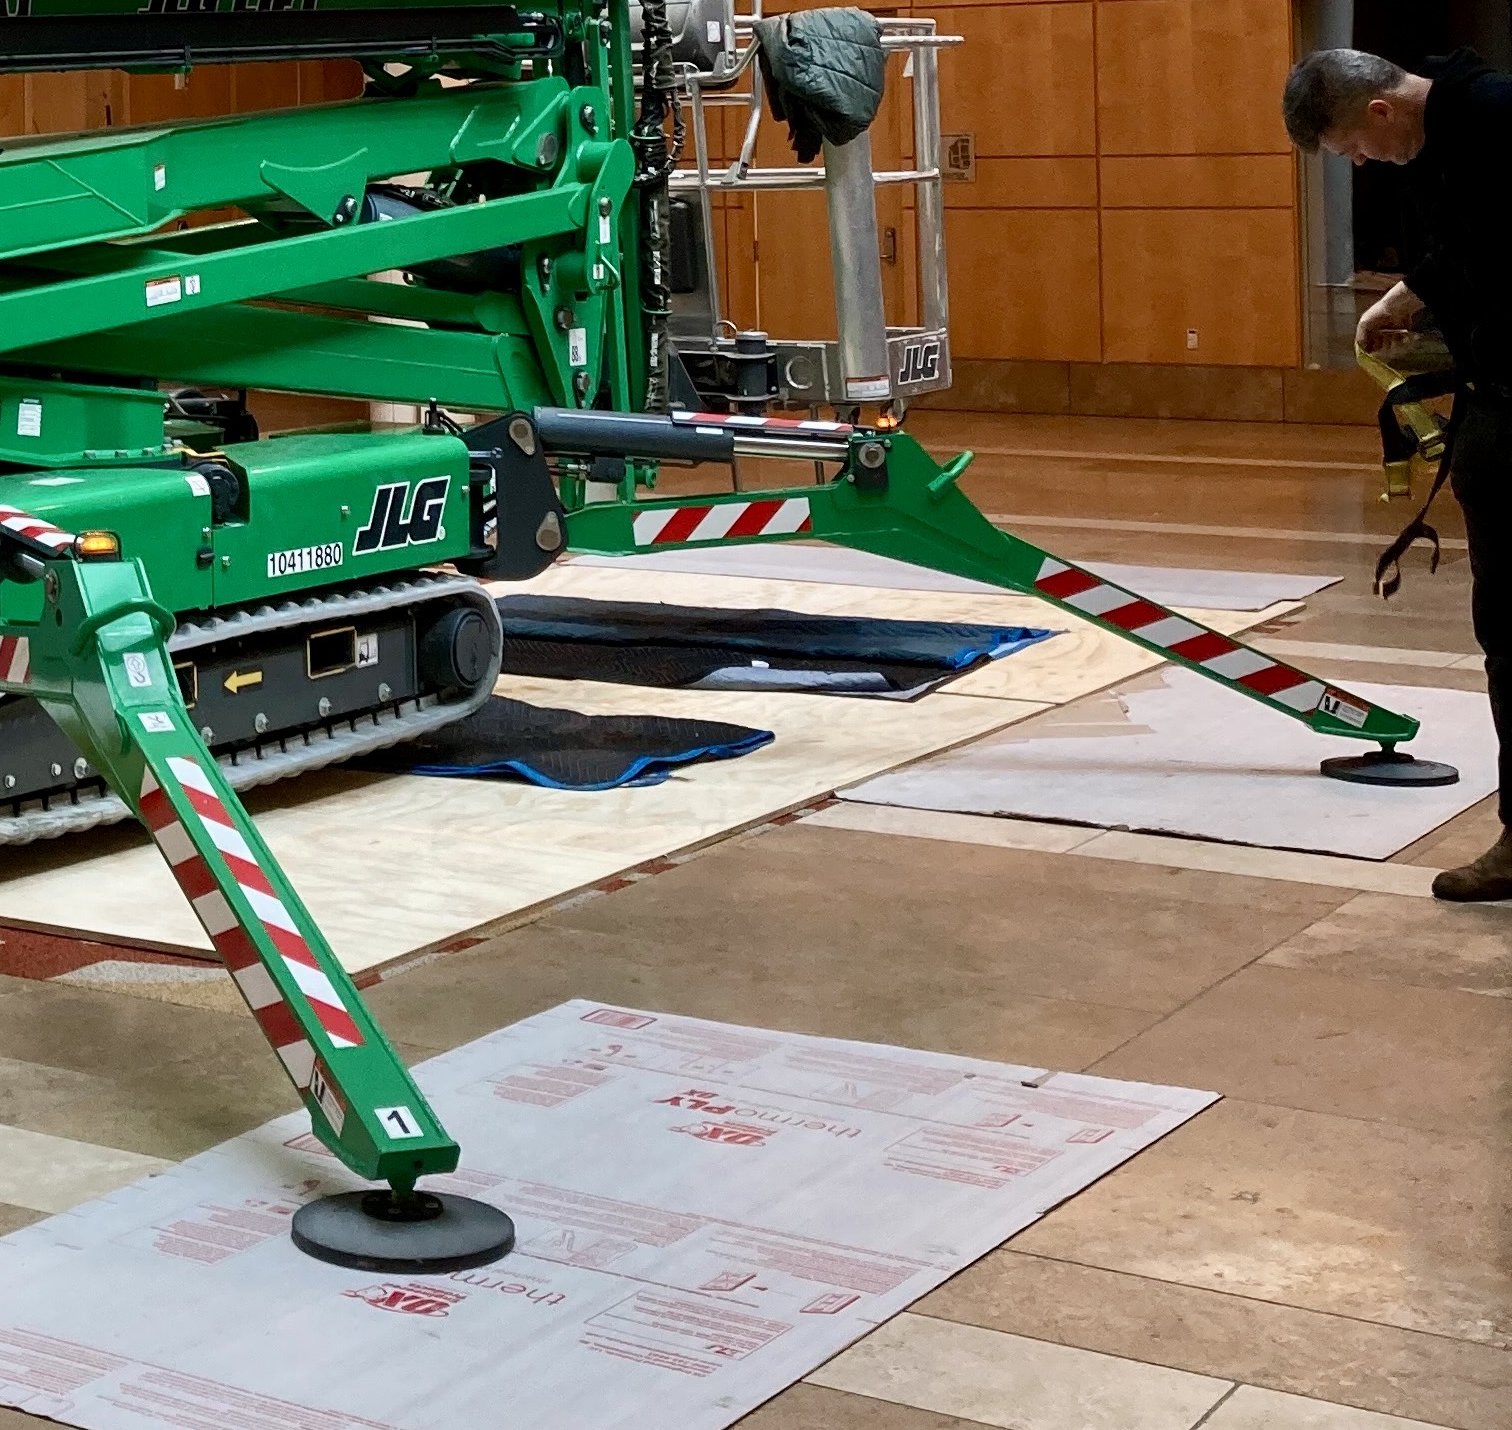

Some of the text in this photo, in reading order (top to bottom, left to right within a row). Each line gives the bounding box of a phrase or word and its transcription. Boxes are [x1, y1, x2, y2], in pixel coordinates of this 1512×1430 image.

[898, 341, 941, 386] JLG
[352, 474, 451, 556] JLG
[269, 543, 342, 576] 10411880
[387, 1109, 411, 1135] 1
